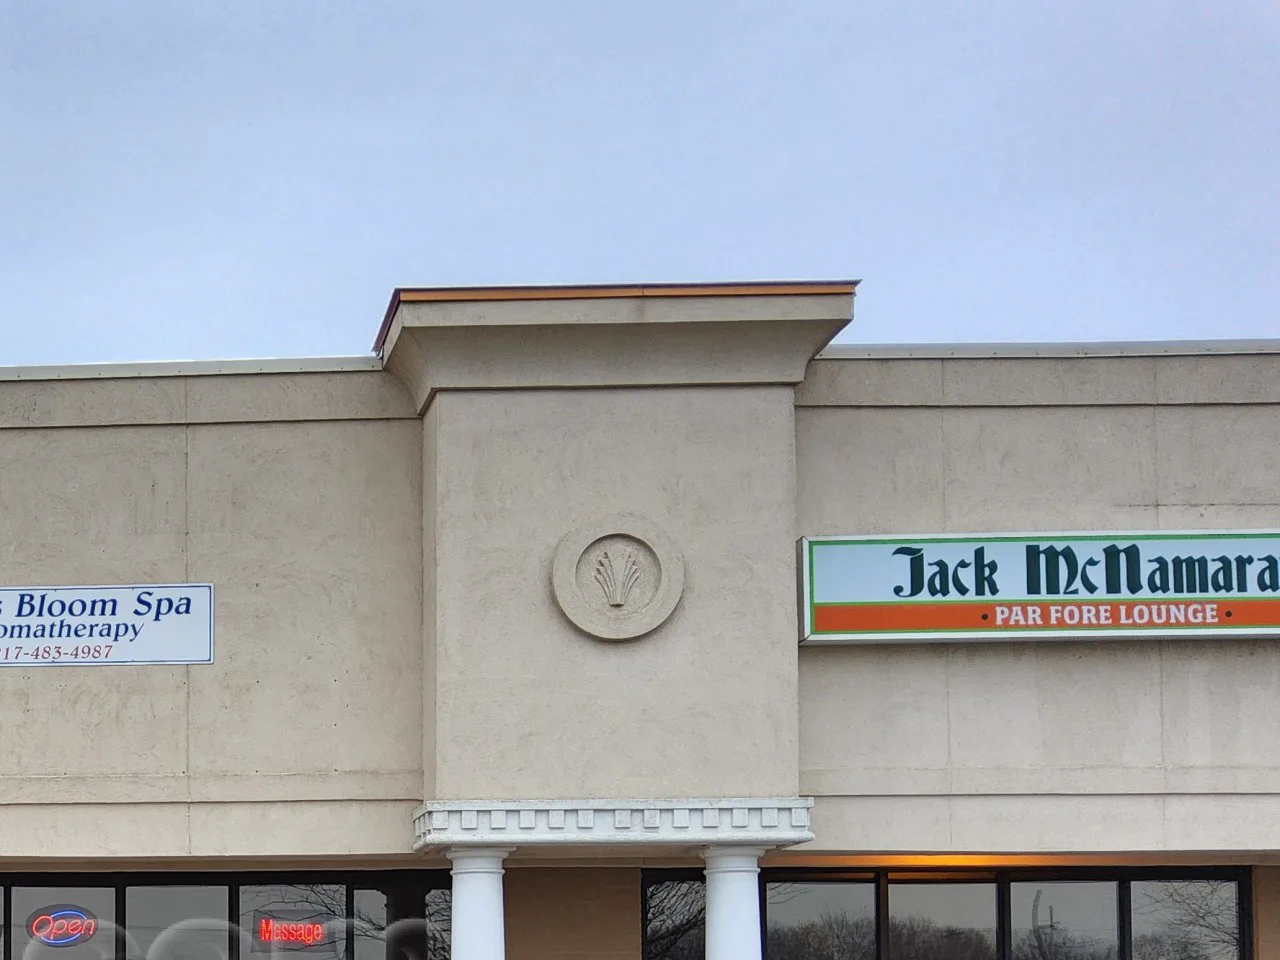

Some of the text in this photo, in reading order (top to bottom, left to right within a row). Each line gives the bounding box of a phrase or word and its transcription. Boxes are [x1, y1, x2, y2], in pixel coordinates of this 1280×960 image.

[891, 546, 1000, 598] Jack
[15, 592, 118, 618] Bloom
[133, 591, 192, 621] Spa
[995, 603, 1219, 625] PAR FORE LOUNGE
[32, 915, 95, 940] Open
[261, 918, 323, 944] Massage
